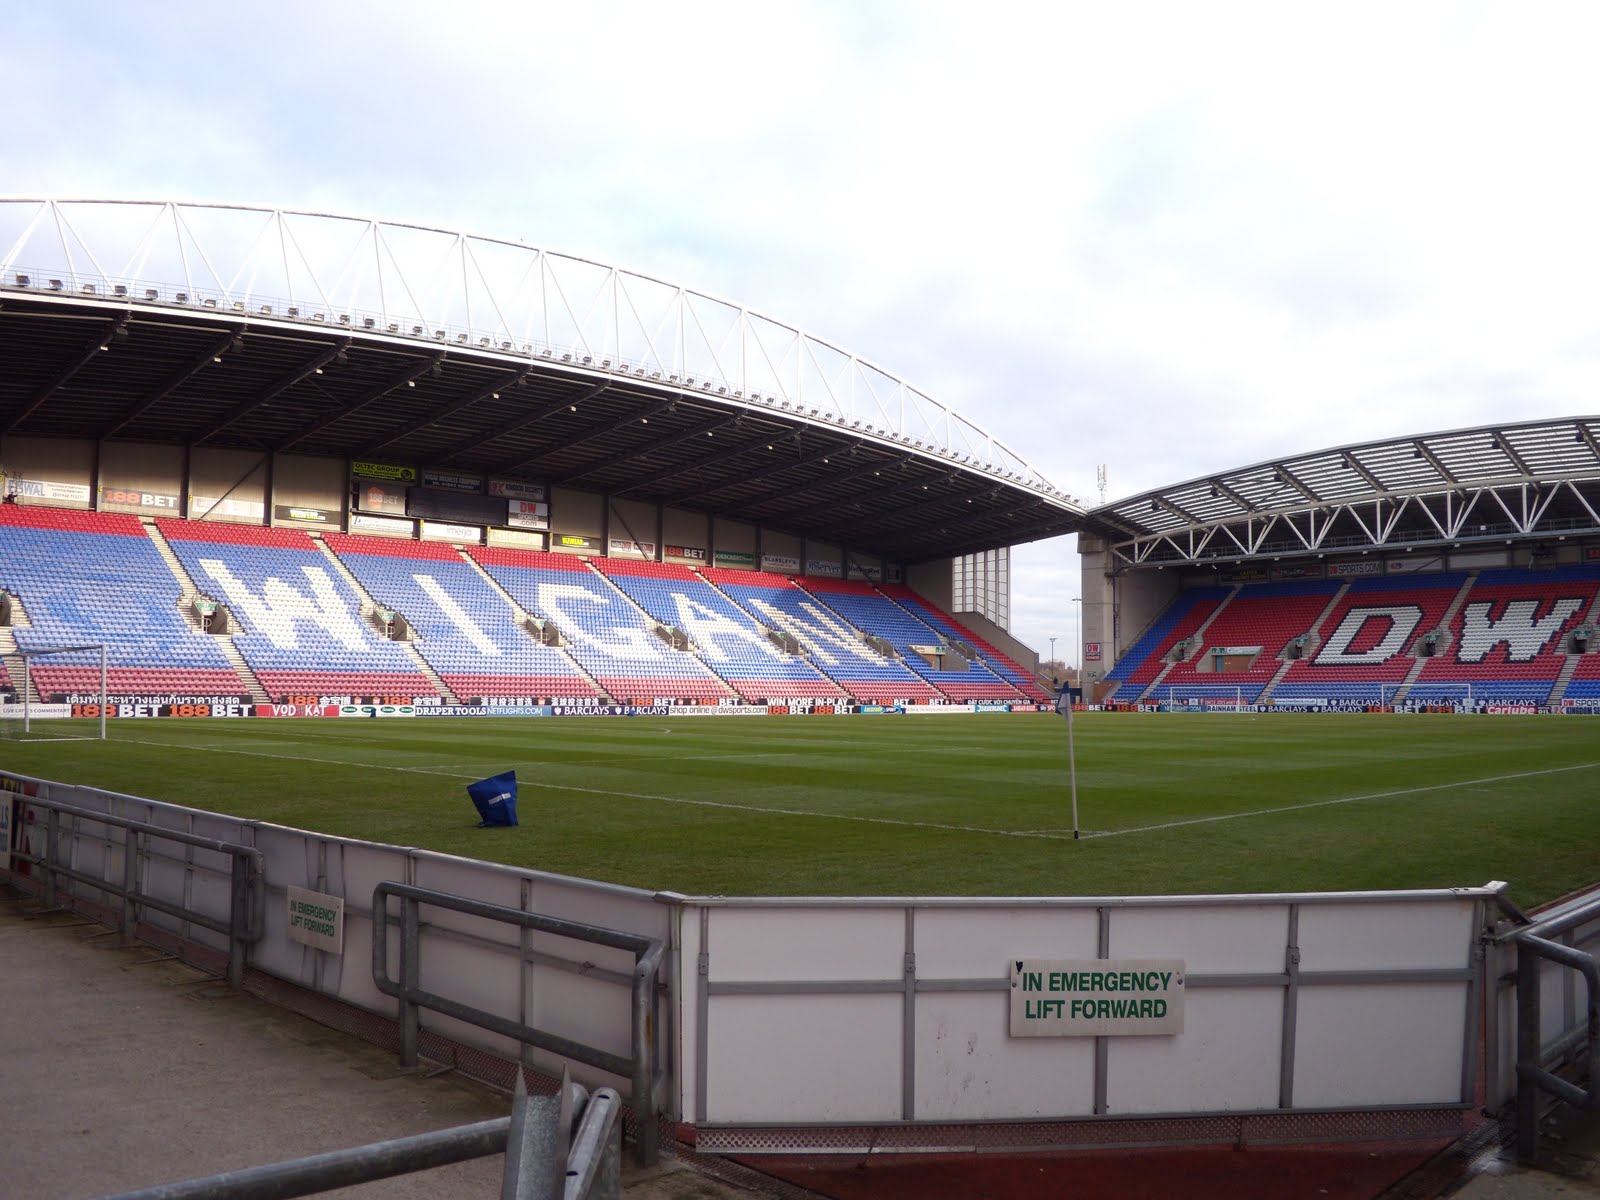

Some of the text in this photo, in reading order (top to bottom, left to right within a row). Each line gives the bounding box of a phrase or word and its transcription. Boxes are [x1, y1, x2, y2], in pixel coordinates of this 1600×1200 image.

[355, 463, 400, 473] OLTEC GROUP
[519, 501, 537, 513] DW
[199, 559, 889, 666] WIGAN
[1310, 597, 1587, 666] DW
[767, 698, 848, 706] WIN MORE IN-PLAY
[1340, 698, 1381, 706] BARCLAYS
[1488, 699, 1536, 707] BARCLAYS
[169, 704, 252, 717] 188BET
[416, 706, 453, 716] DRAPER
[455, 706, 487, 716] TOOLS
[564, 707, 609, 715] BARCLAYS
[624, 707, 667, 715] BARCLAYS
[670, 706, 688, 715] shop
[689, 706, 710, 714] online
[1207, 705, 1257, 713] RAINHAM STEEL
[1268, 705, 1308, 713] BARCLAYS
[1321, 705, 1363, 713] BARCLAYS
[1487, 706, 1536, 715] Carlube
[291, 900, 337, 922] IN EMERGENCY
[291, 914, 335, 937] LIFT FORWARD
[1022, 972, 1172, 991] IN EMERGENCY
[1025, 999, 1167, 1019] LIFT FORWARD
